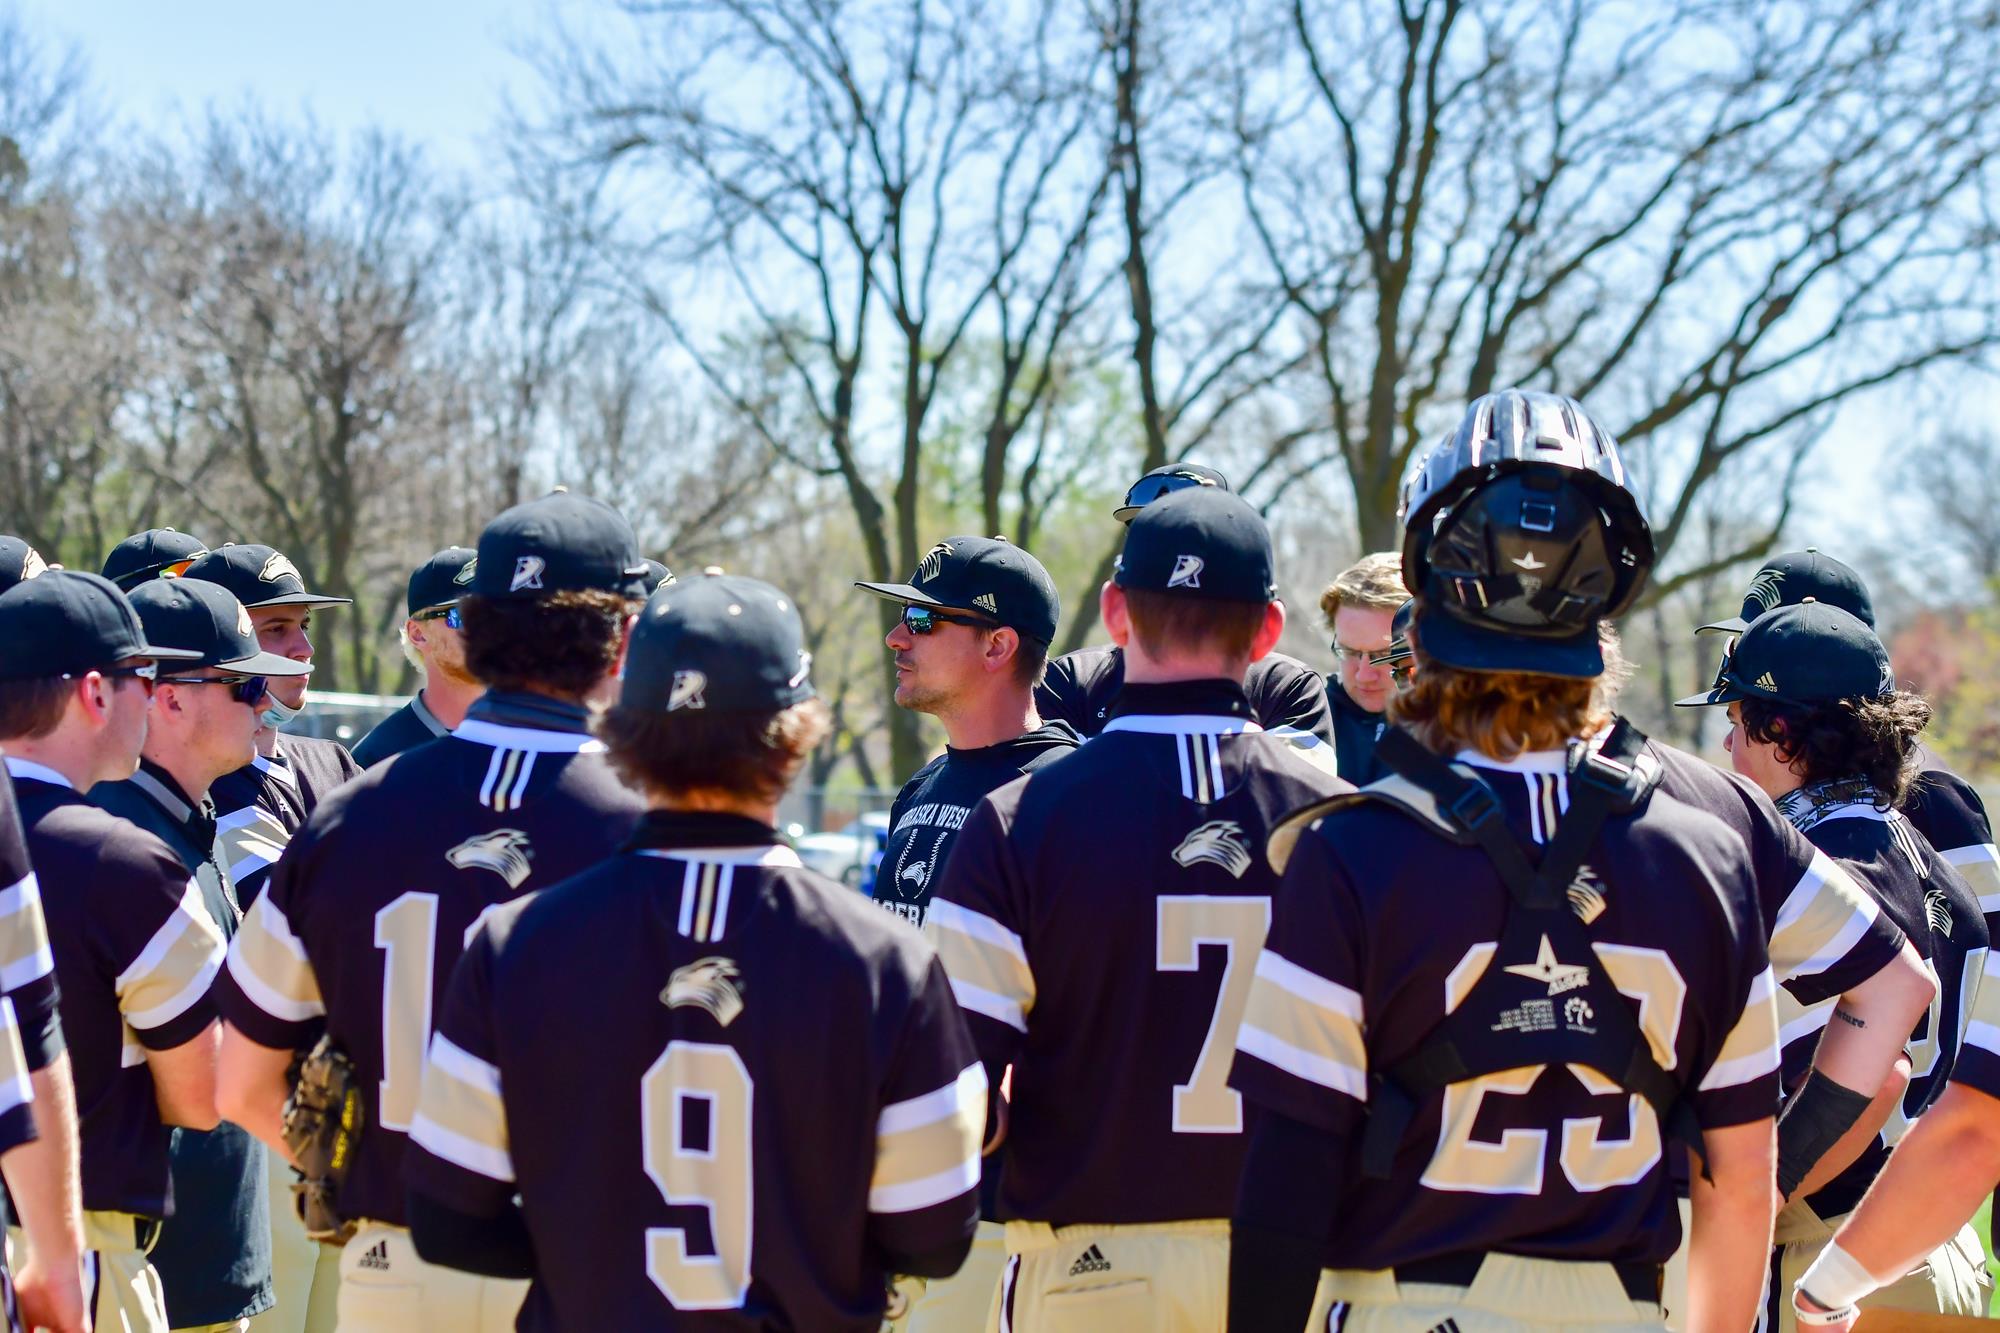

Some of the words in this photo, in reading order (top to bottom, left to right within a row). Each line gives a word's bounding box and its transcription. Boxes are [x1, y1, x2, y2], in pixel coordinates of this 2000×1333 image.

[972, 598, 998, 613] adidas
[375, 891, 484, 1133] 1
[1156, 895, 1273, 1133] 7
[641, 1040, 754, 1310] 9
